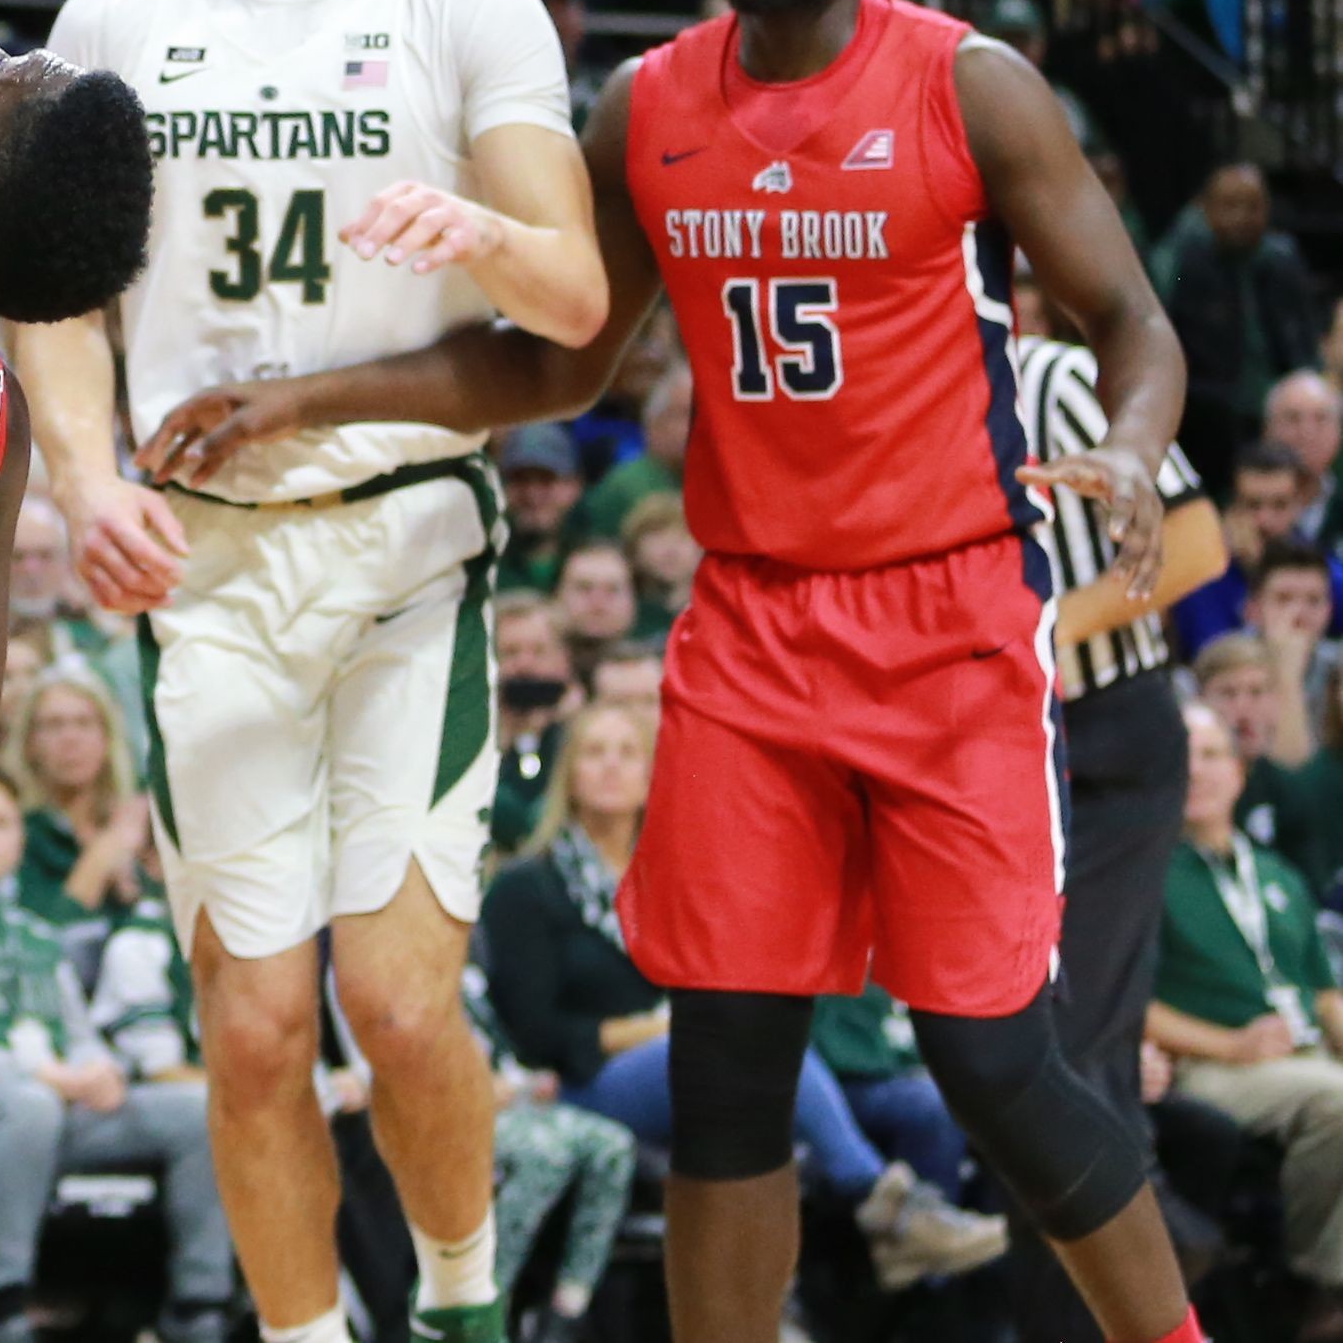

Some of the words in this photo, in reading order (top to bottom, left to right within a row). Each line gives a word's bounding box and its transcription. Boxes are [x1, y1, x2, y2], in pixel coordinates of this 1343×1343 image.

[147, 110, 392, 160] SPARTANS
[202, 187, 333, 306] 34
[665, 209, 767, 259] STONY
[781, 211, 890, 260] BROOK
[722, 277, 845, 402] 15
